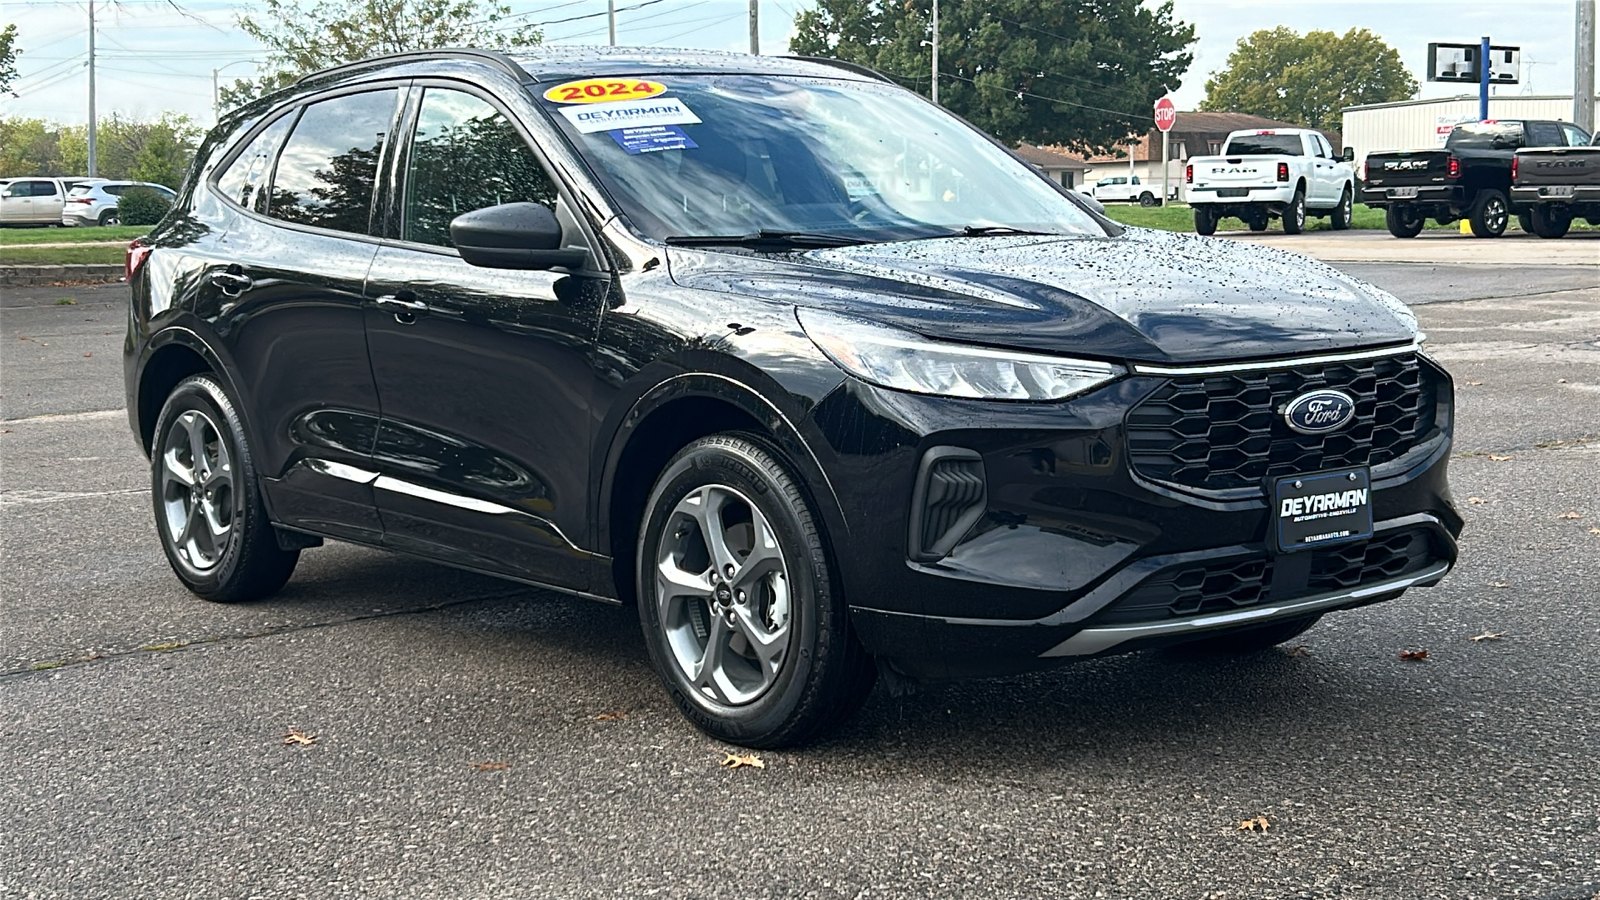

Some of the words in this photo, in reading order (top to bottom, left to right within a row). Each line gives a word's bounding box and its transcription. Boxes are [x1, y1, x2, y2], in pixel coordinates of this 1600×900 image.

[560, 82, 655, 100] 2024
[577, 106, 680, 121] DEYARMAN
[1156, 107, 1174, 121] STOP
[1385, 160, 1430, 170] RAM
[1537, 160, 1585, 168] RAM
[1304, 400, 1342, 424] Ford
[1281, 489, 1367, 517] DEYARMAN
